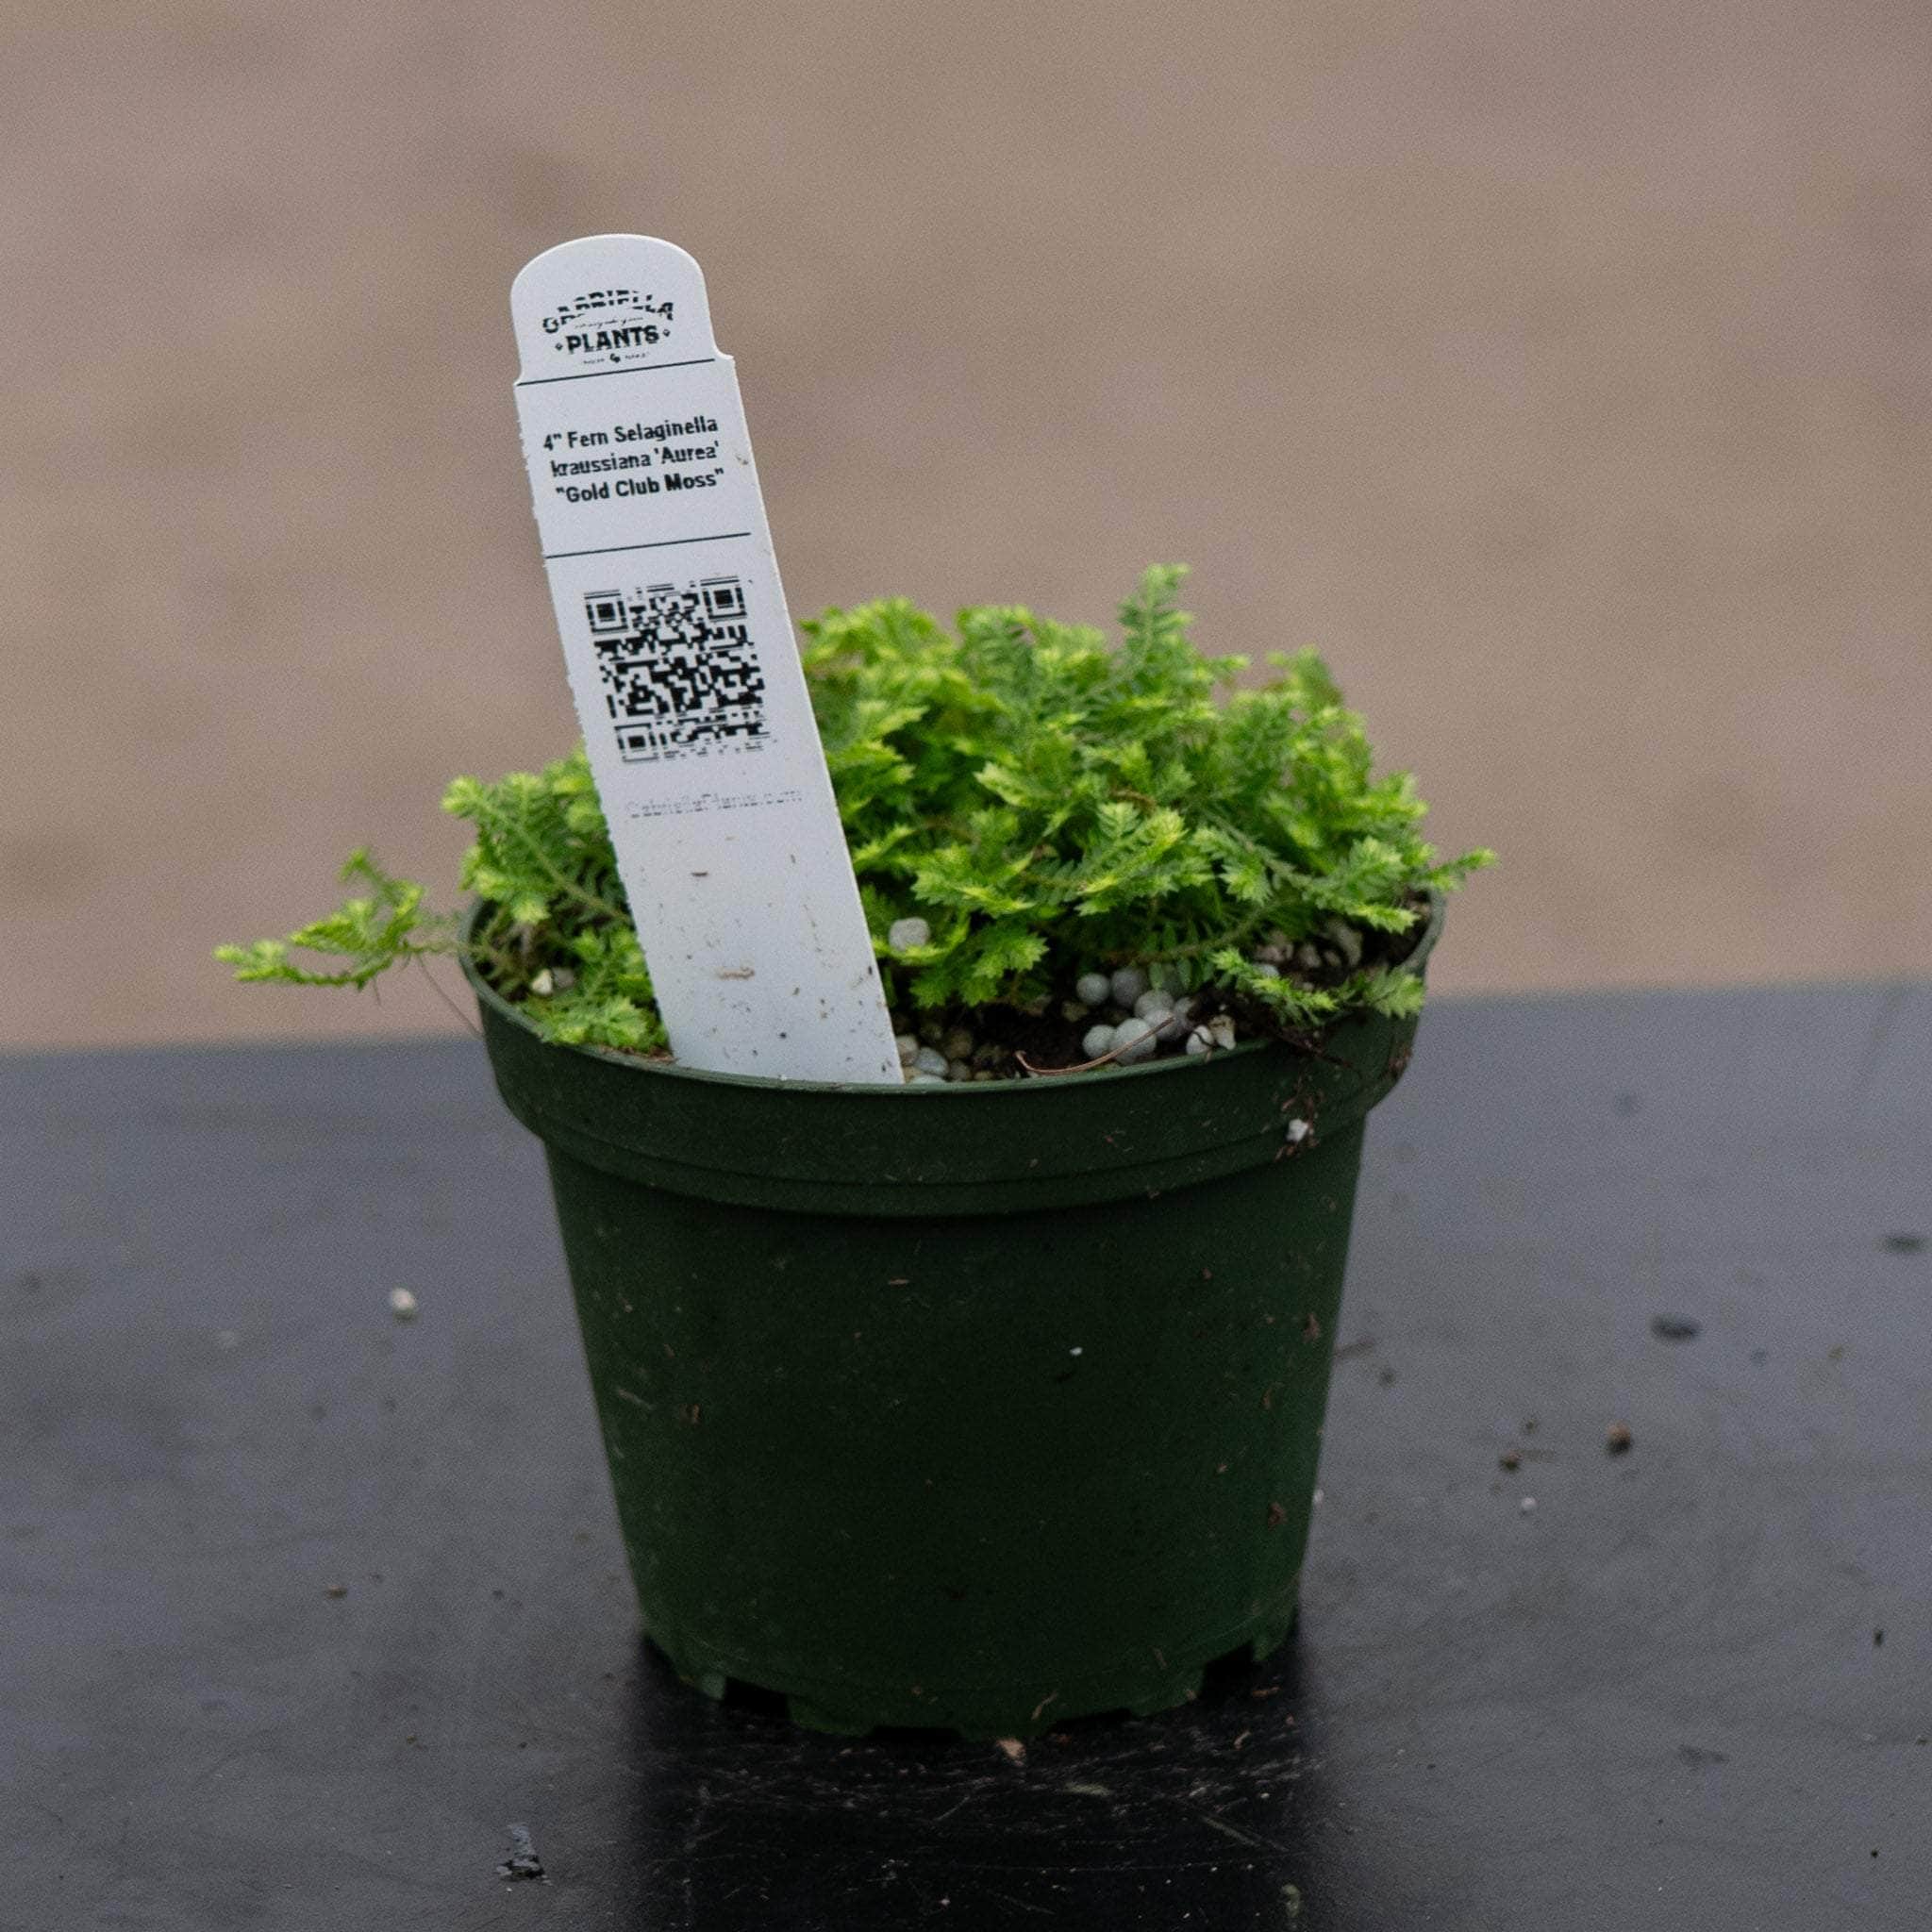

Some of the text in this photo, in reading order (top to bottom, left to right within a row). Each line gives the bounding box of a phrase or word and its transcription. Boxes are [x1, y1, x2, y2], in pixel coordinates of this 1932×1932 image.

[566, 325, 659, 355] PLANTS
[543, 415, 719, 451] 4" Fern Selaginella
[551, 453, 652, 477] kraussiana
[556, 468, 724, 504] "Gold Club Moss"
